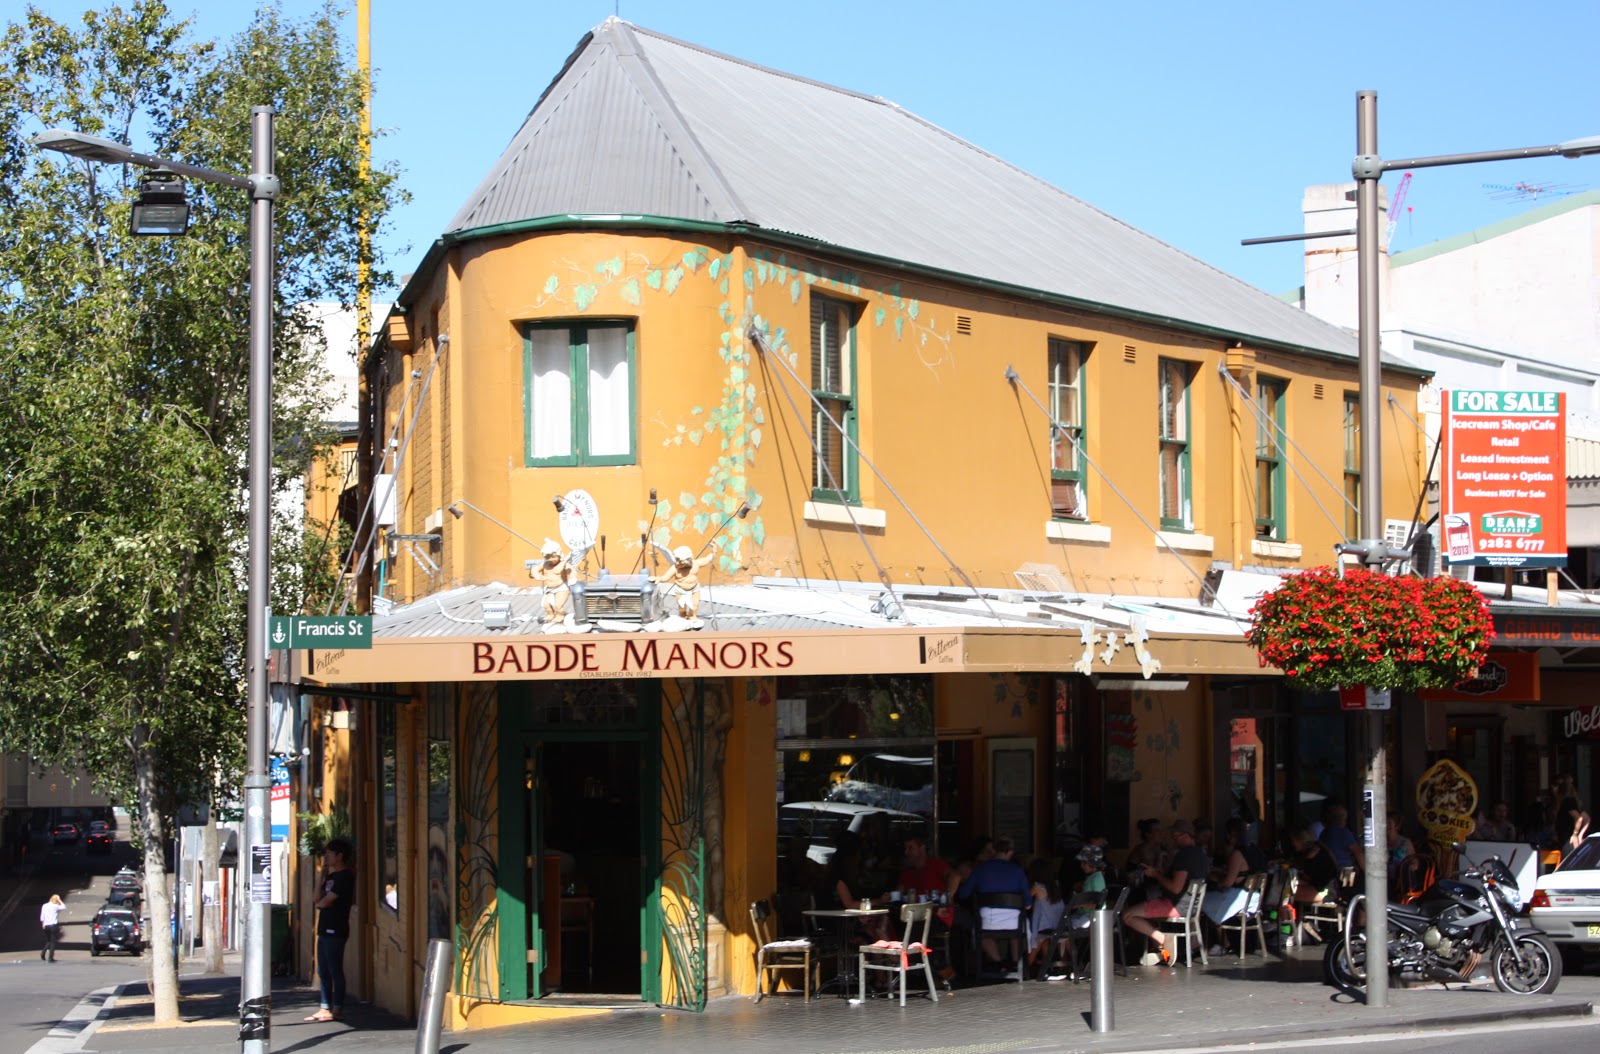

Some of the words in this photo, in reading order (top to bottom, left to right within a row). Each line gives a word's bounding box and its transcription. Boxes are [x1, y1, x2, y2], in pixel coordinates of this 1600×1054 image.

[1457, 391, 1499, 411] FOR
[1503, 392, 1556, 412] SALE
[1452, 419, 1500, 430] Icecream
[1501, 419, 1556, 432] Shop/Cafe
[1491, 437, 1520, 447] Retail
[1460, 453, 1494, 464] Leased
[1495, 454, 1550, 465] Investment
[1456, 470, 1481, 482] Long
[1483, 471, 1510, 481] Lease
[1519, 471, 1553, 483] Option
[1464, 489, 1498, 497] Business
[1516, 490, 1528, 498] for
[1528, 490, 1546, 498] Sale
[1485, 517, 1537, 528] DEANS
[1452, 544, 1469, 556] 2013
[1479, 537, 1512, 550] 9282
[1515, 537, 1545, 551] 6777
[298, 620, 345, 636] Francis
[348, 620, 363, 636] St
[1504, 620, 1561, 640] GRAND
[472, 642, 600, 674] BADDE
[621, 639, 794, 671] MANORS
[579, 671, 624, 679] ESTABLISHED
[1563, 705, 1600, 739] Wel
